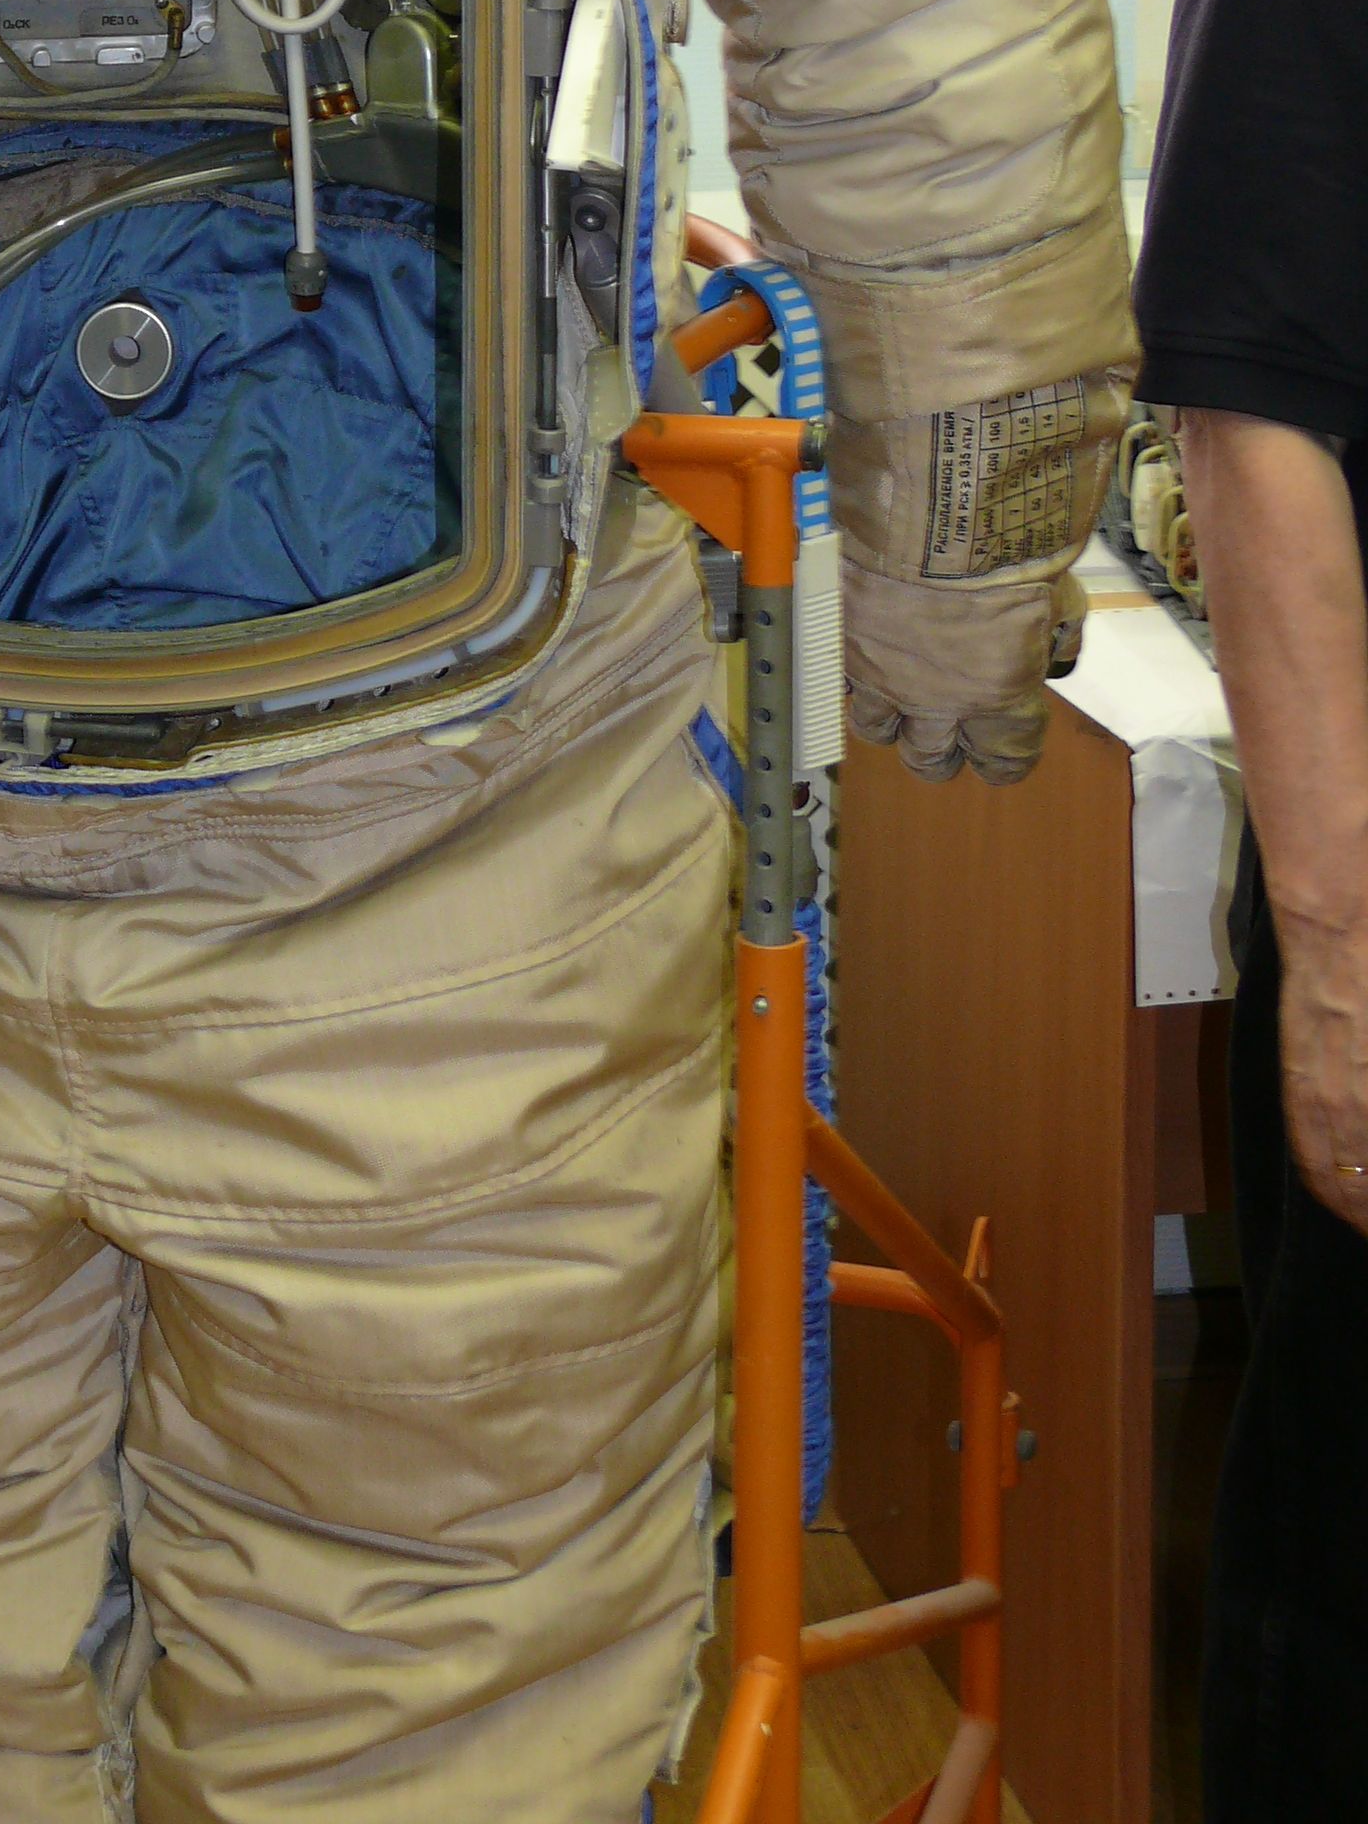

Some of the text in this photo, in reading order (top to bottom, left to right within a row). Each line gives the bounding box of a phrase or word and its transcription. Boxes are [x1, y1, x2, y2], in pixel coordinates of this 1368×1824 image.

[988, 421, 1001, 443] 100
[1018, 416, 1030, 435] 1,5
[986, 452, 1000, 474] 200
[933, 410, 955, 554] РАСПОЛАГАЕМОЕ ВРЕМЯ
